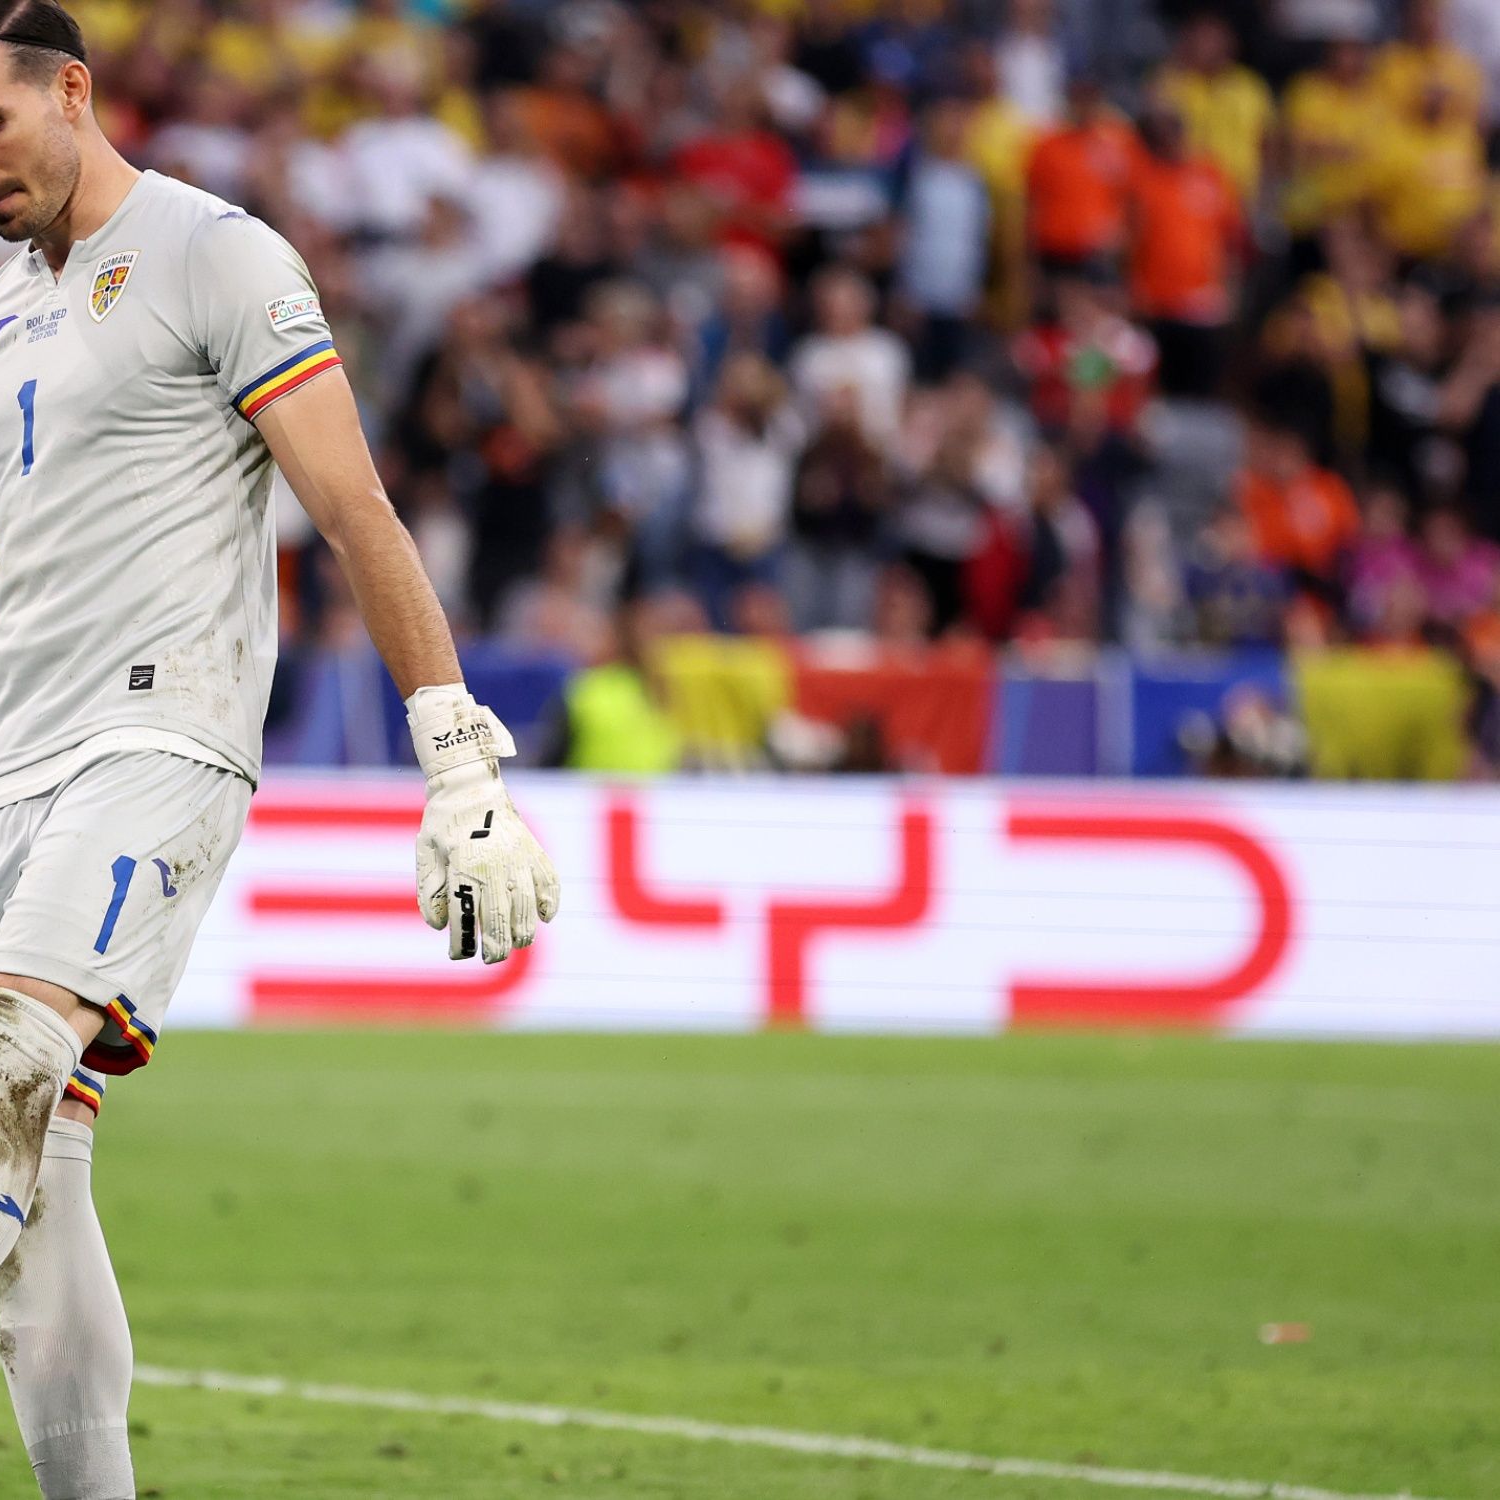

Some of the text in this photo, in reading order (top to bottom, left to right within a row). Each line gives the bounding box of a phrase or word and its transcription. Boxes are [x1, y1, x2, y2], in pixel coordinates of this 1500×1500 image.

[268, 299, 285, 311] UEFA
[26, 314, 44, 330] ROU
[50, 308, 67, 321] NED
[17, 378, 37, 477] 1
[431, 722, 490, 742] NITA
[435, 730, 492, 752] FLORIN
[93, 855, 137, 955] 1
